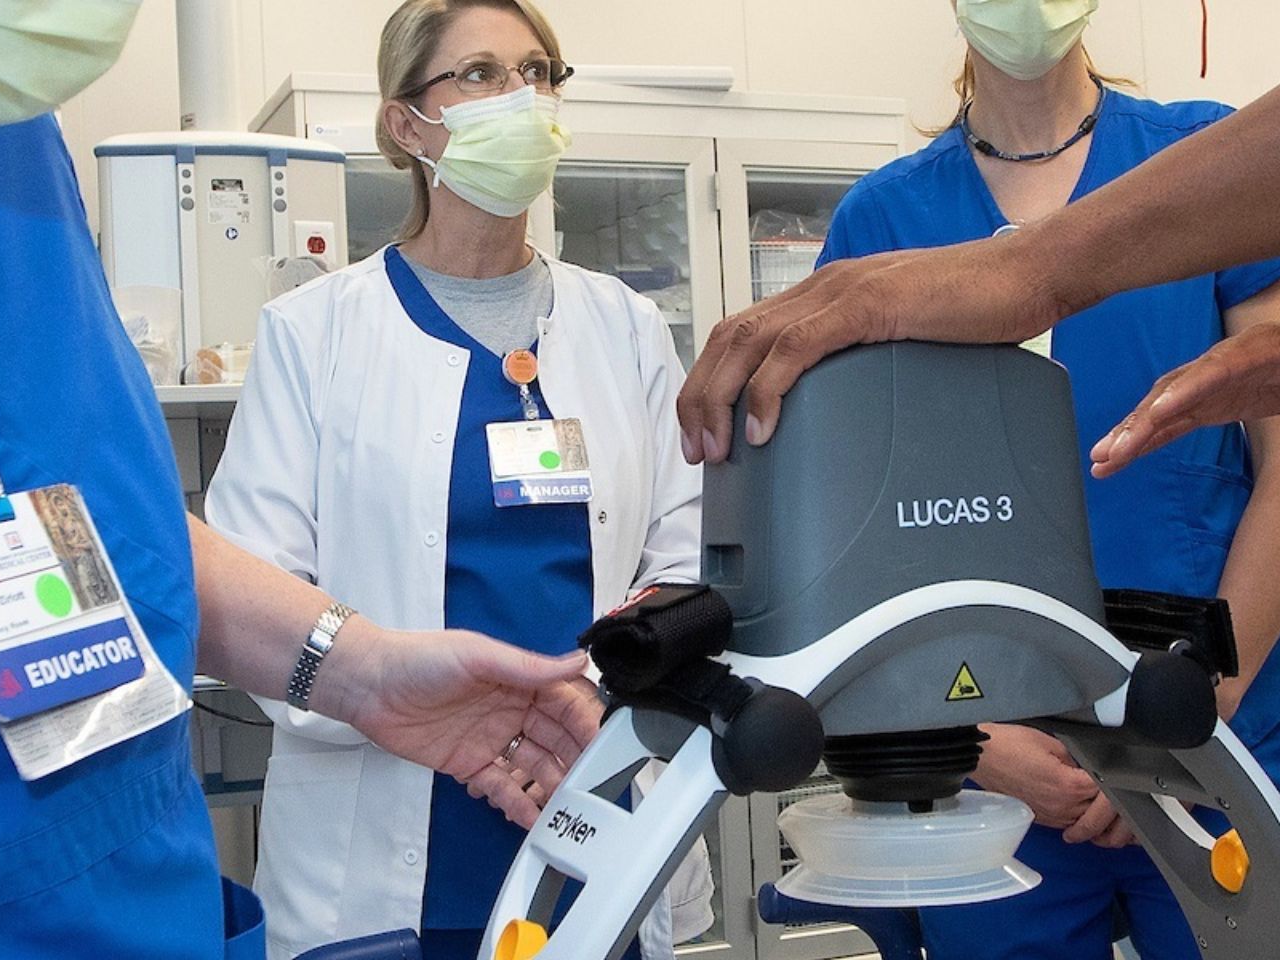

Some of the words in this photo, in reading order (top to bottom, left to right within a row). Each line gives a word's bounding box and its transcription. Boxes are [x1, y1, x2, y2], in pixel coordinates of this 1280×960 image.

[520, 484, 590, 498] MANAGER
[897, 496, 991, 528] LUCAS
[996, 495, 1014, 521] 3
[24, 636, 137, 688] EDUCATOR
[547, 806, 596, 845] stryker
